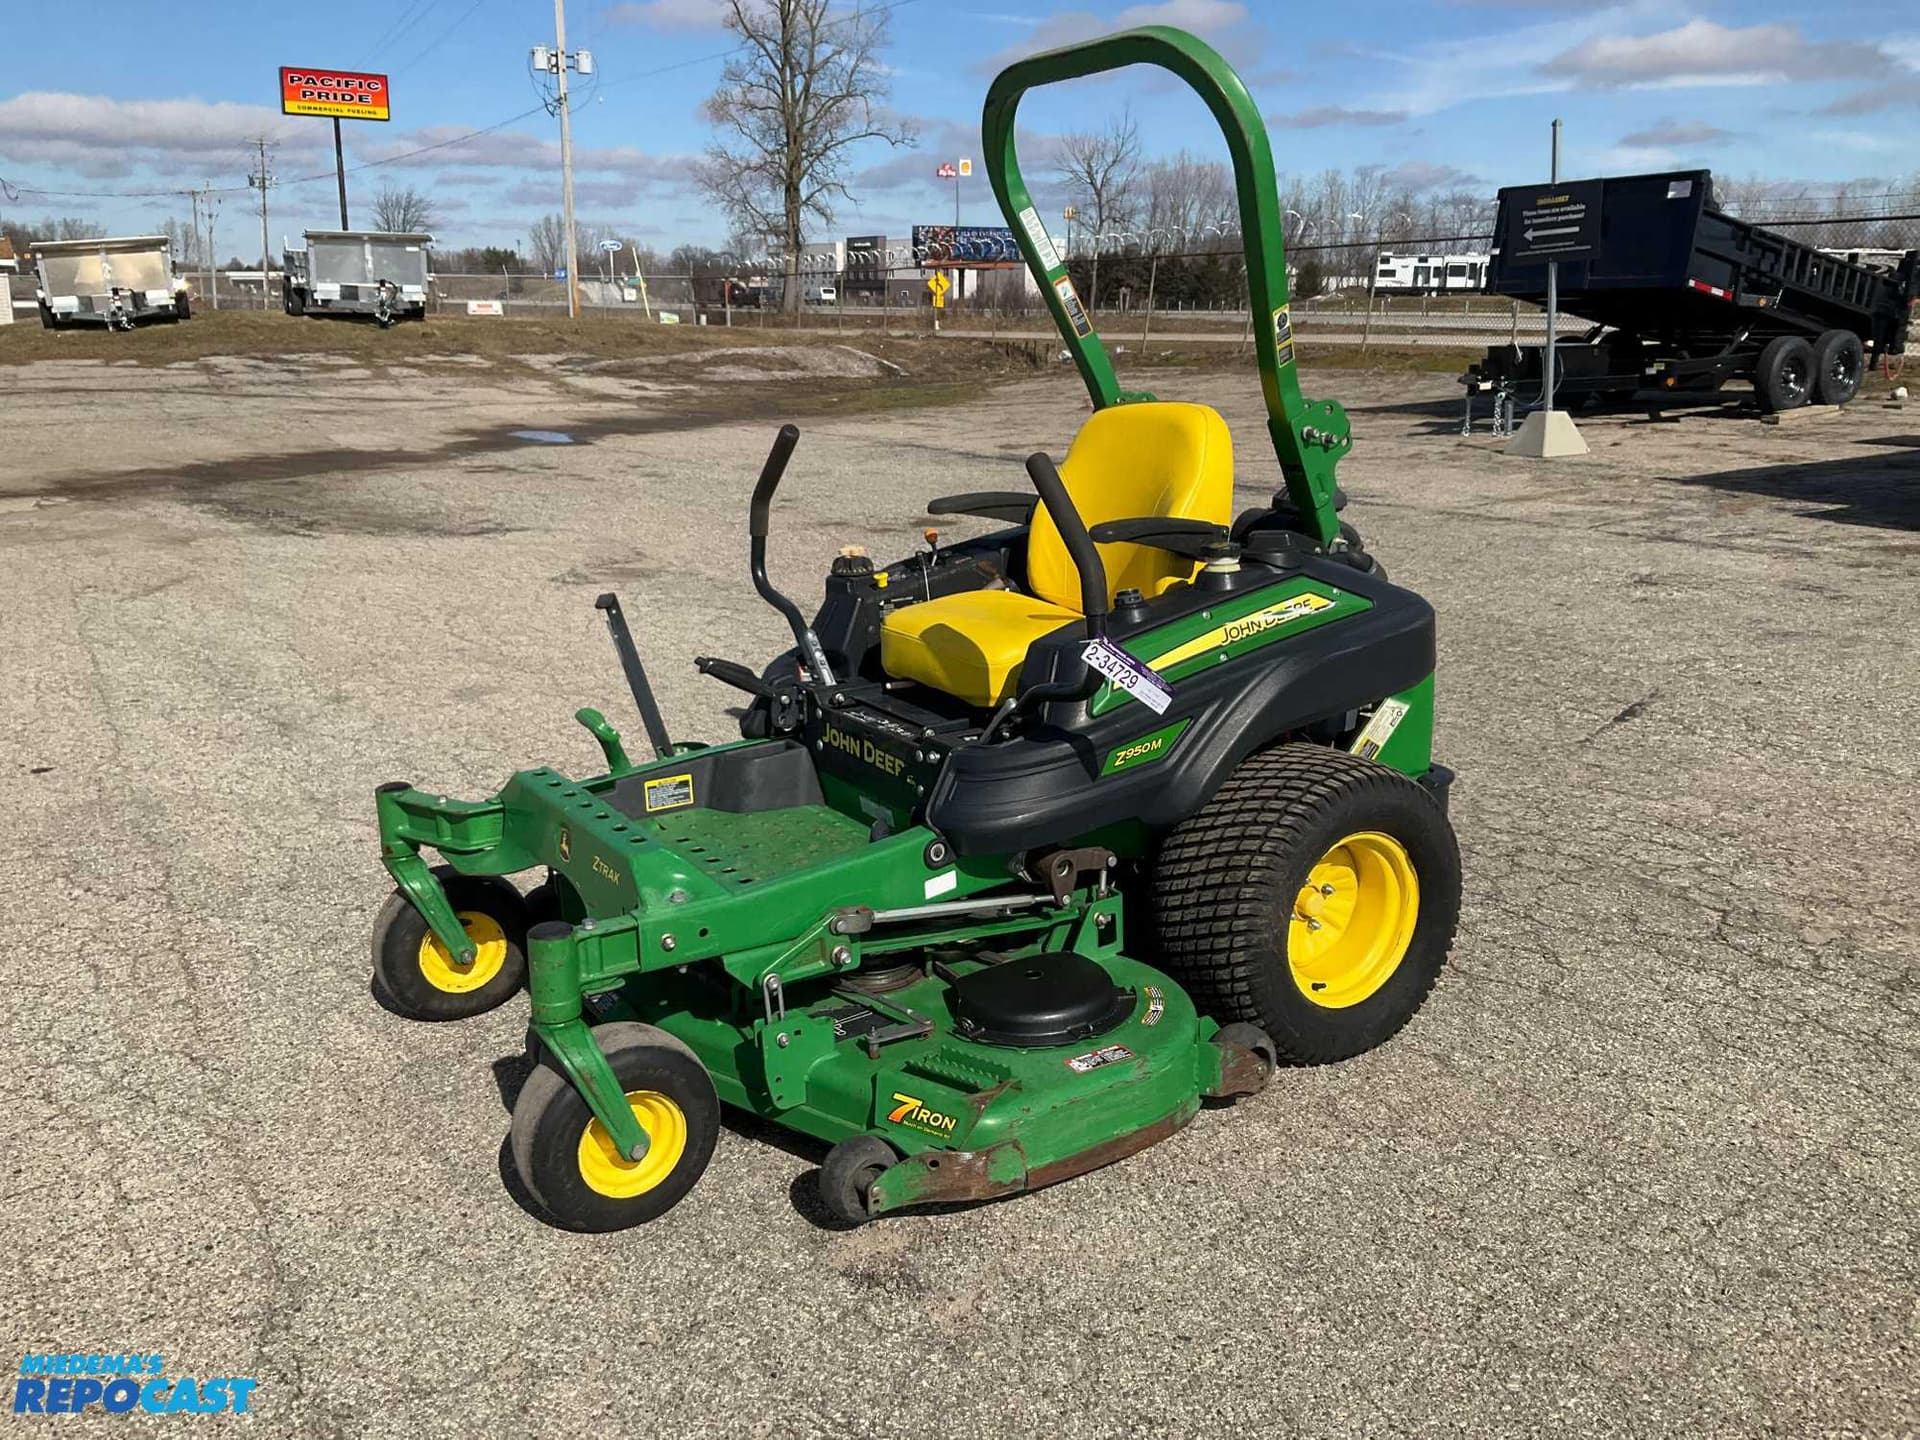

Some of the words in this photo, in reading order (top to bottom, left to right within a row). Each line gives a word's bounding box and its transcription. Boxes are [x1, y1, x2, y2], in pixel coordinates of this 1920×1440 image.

[288, 75, 381, 90] PACIFIC
[301, 90, 372, 104] PRIDE
[297, 105, 343, 113] COMMERCIAL
[1221, 620, 1262, 644] JOHN
[1263, 599, 1311, 626] DRE
[1086, 645, 1139, 689] 2-34729
[822, 722, 861, 758] JOHN
[863, 739, 911, 781] DEER
[1114, 738, 1162, 767] Z950M
[592, 855, 621, 886] ZTRAK
